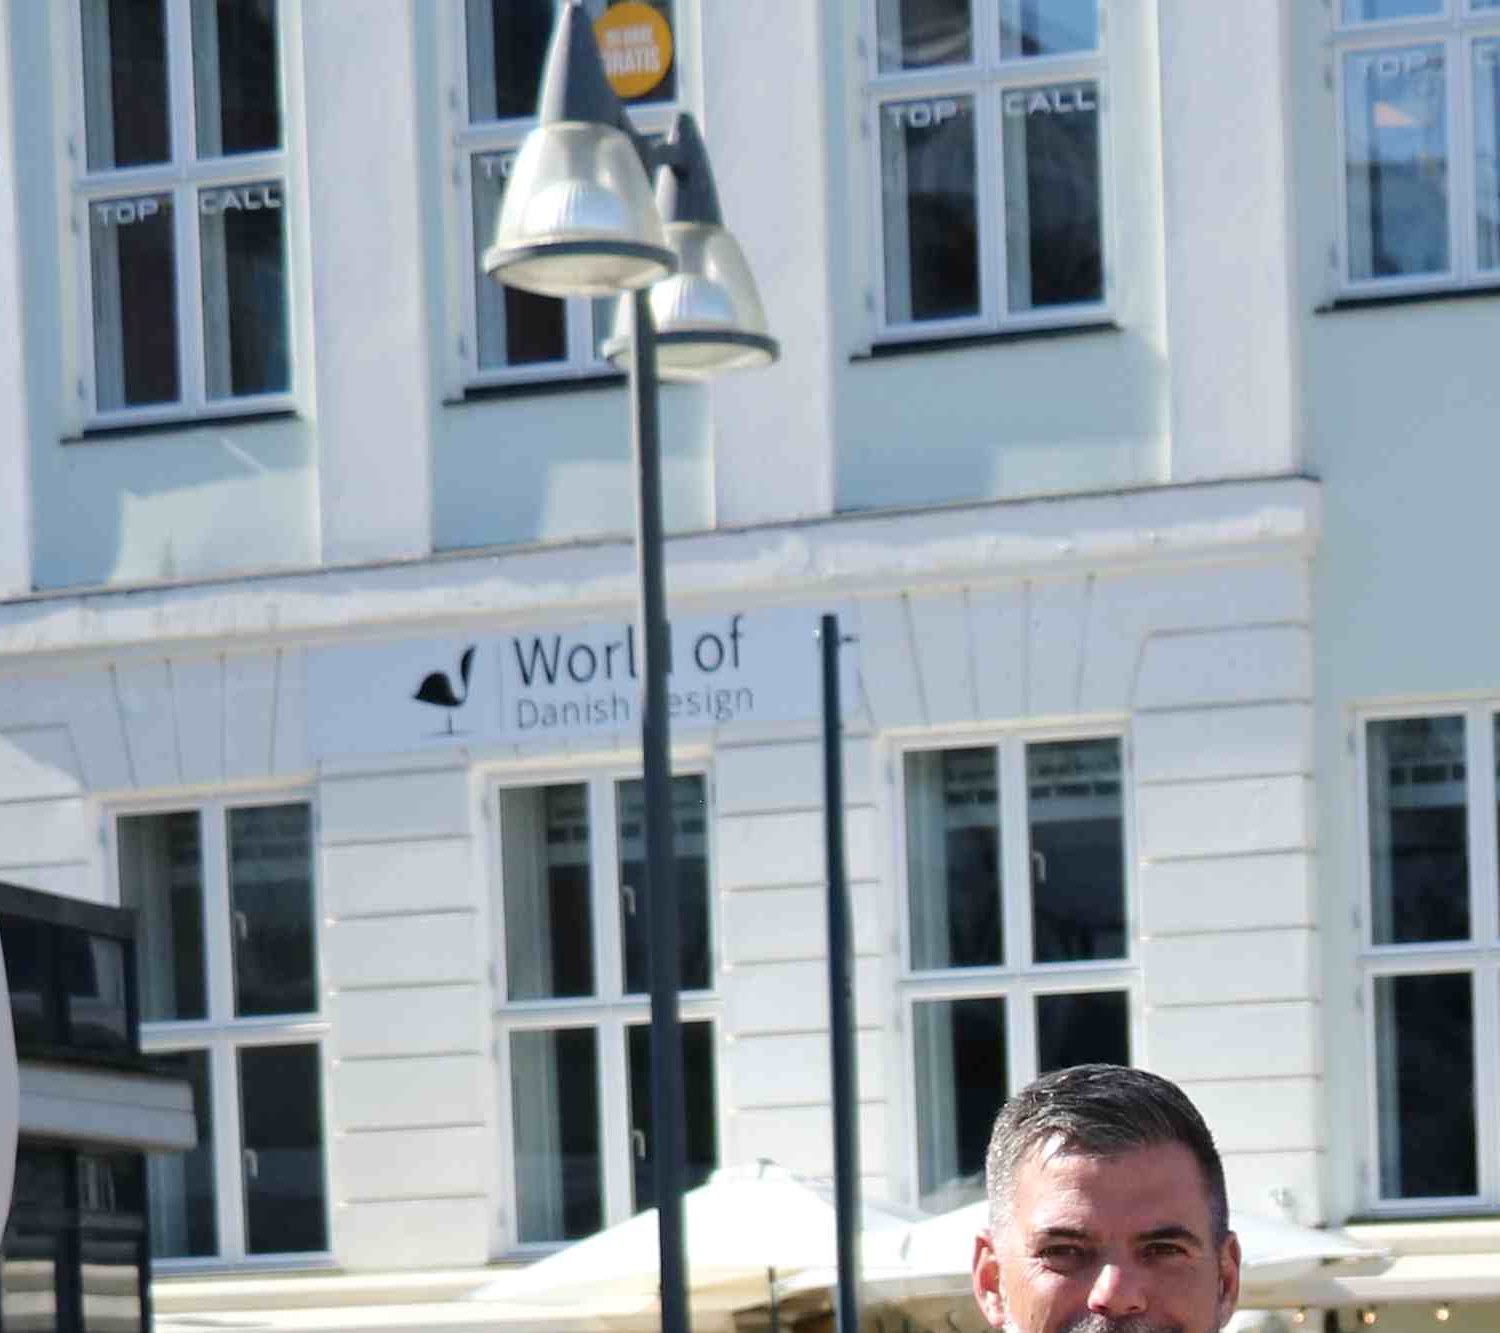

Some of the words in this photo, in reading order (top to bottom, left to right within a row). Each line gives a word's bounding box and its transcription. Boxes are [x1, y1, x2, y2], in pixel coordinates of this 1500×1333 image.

[1355, 52, 1428, 81] TOP
[887, 100, 957, 129] TOP
[1004, 86, 1095, 114] CALL
[98, 199, 159, 226] TOP
[200, 187, 282, 216] CALL
[694, 613, 744, 673] of
[516, 691, 631, 730] Danish
[667, 684, 754, 723] esign
